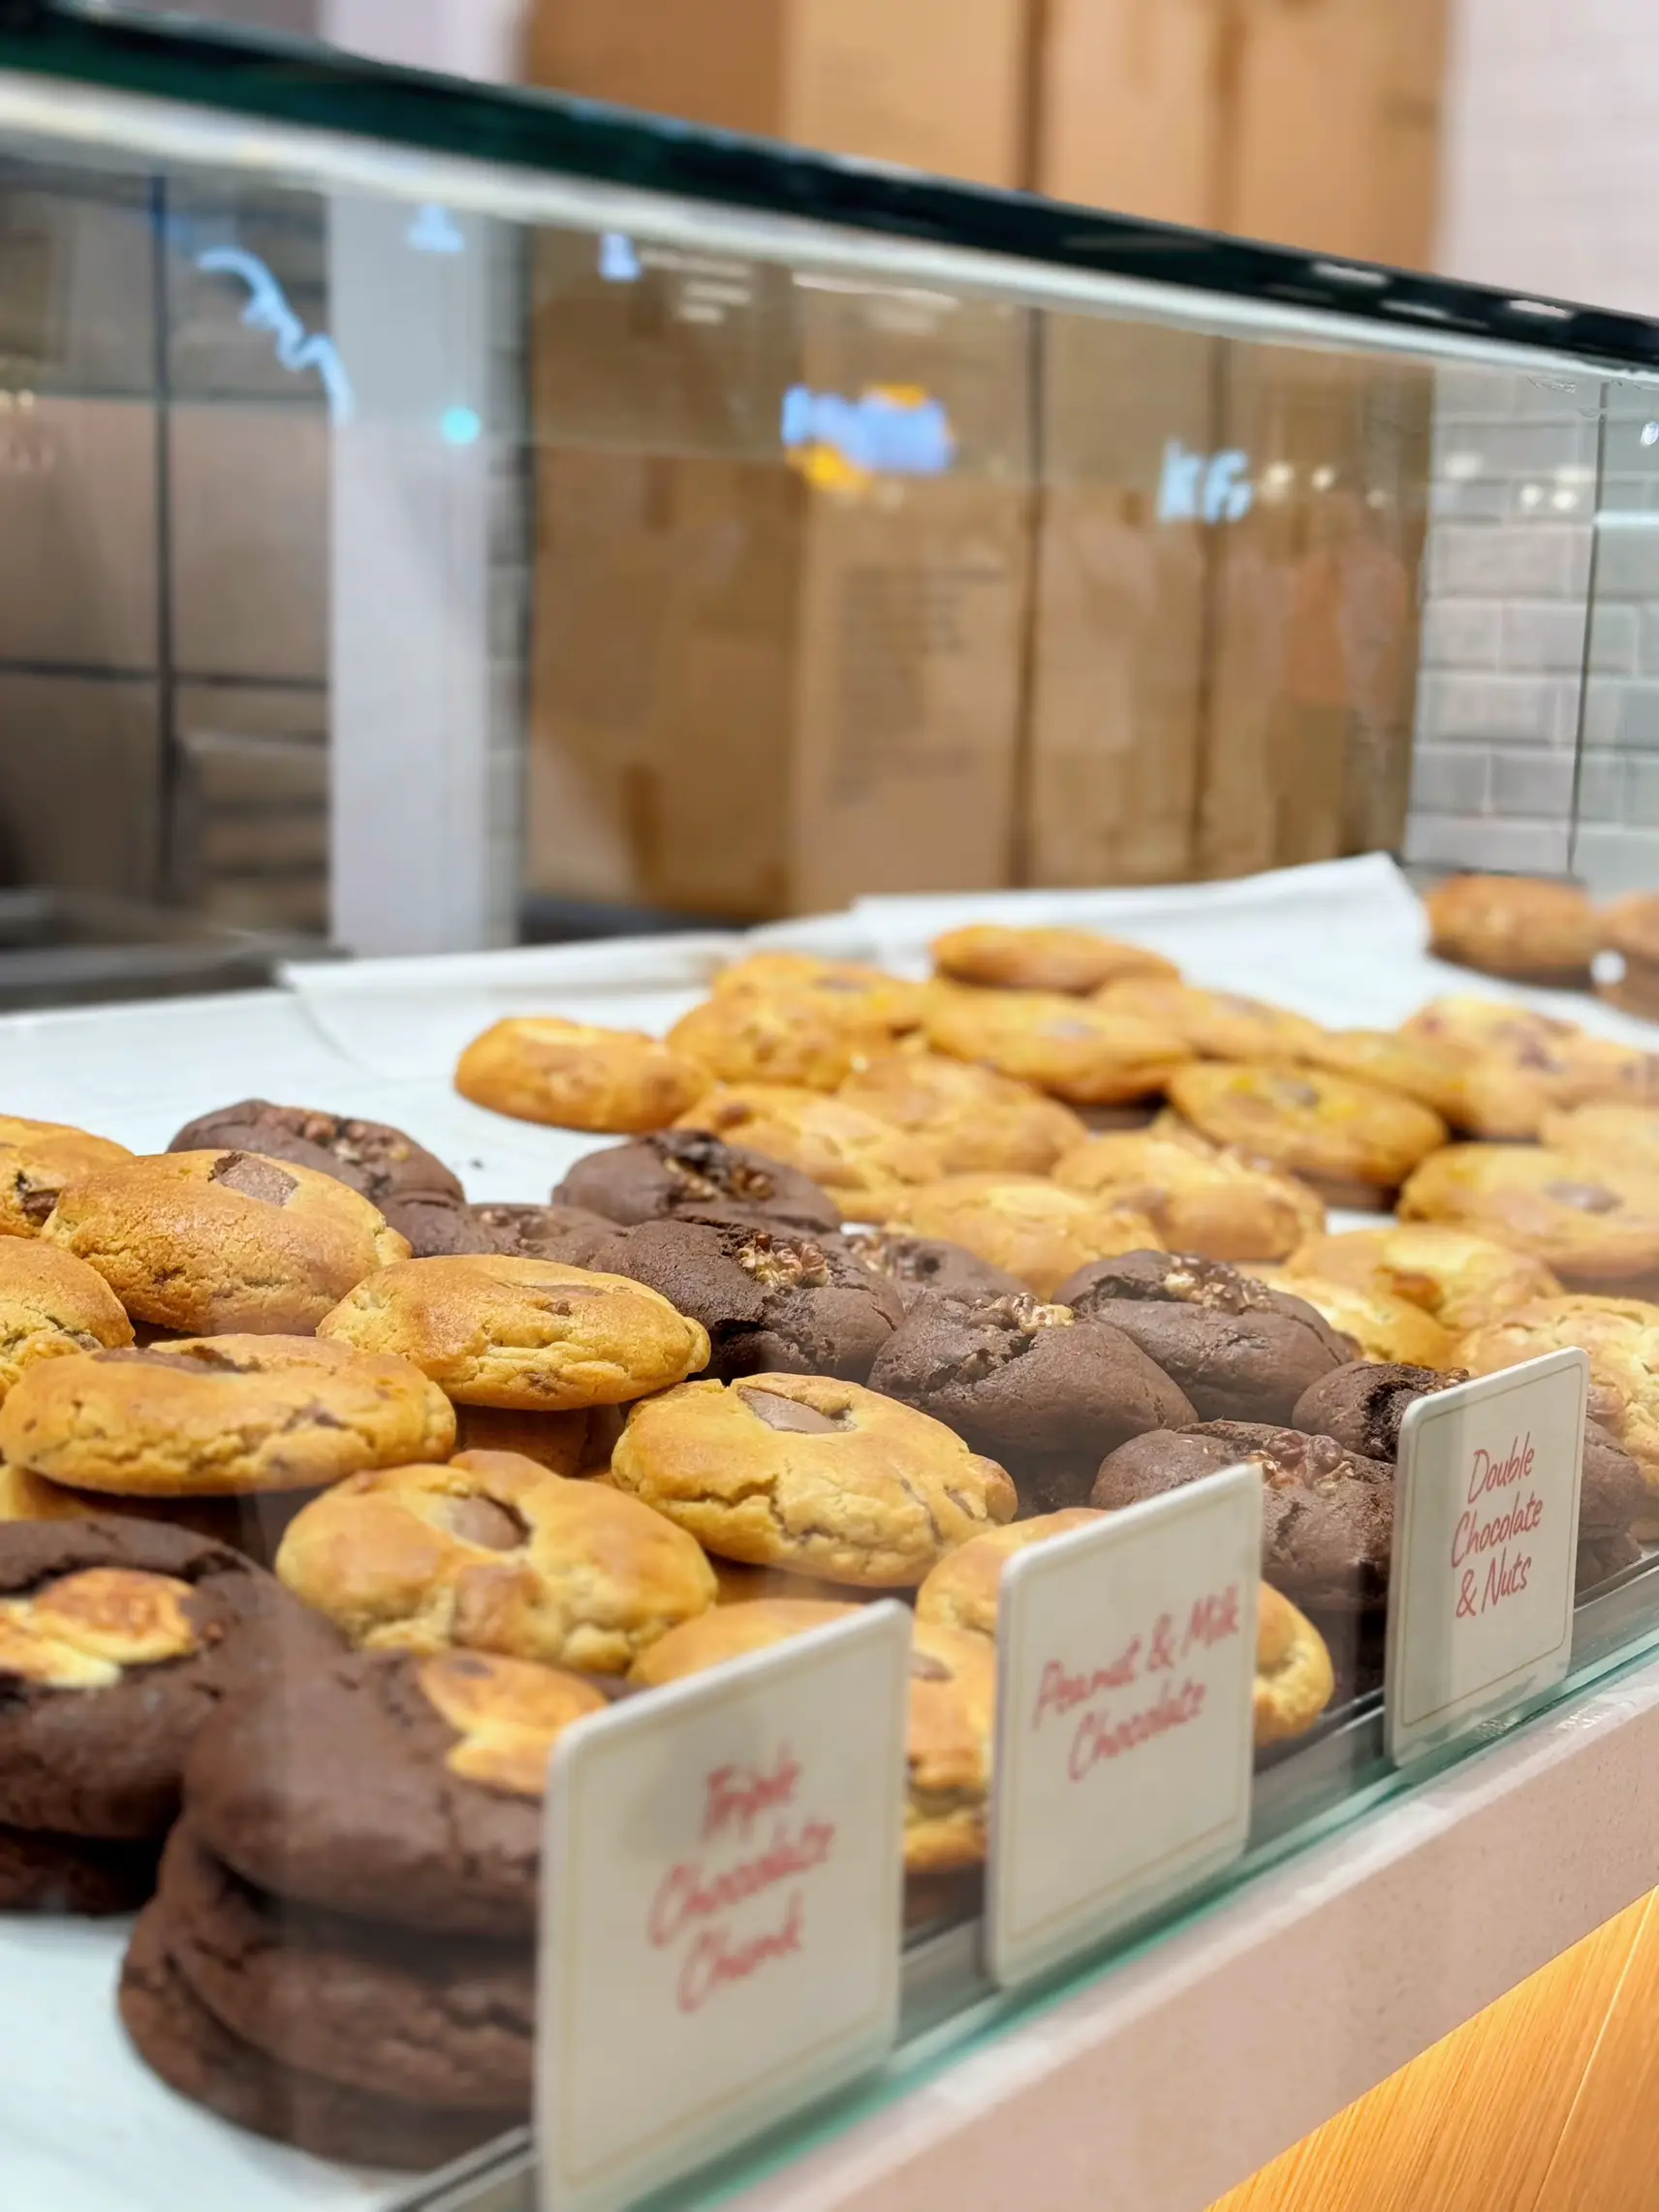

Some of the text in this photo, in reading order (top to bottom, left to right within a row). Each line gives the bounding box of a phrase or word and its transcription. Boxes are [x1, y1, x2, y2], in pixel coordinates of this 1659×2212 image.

[1468, 1431, 1535, 1504] Double
[1452, 1491, 1544, 1569] Chocolate
[1456, 1547, 1532, 1618] & Nuts
[1034, 1584, 1239, 1730] Peanut & Milk
[1068, 1680, 1206, 1782] Chocolate
